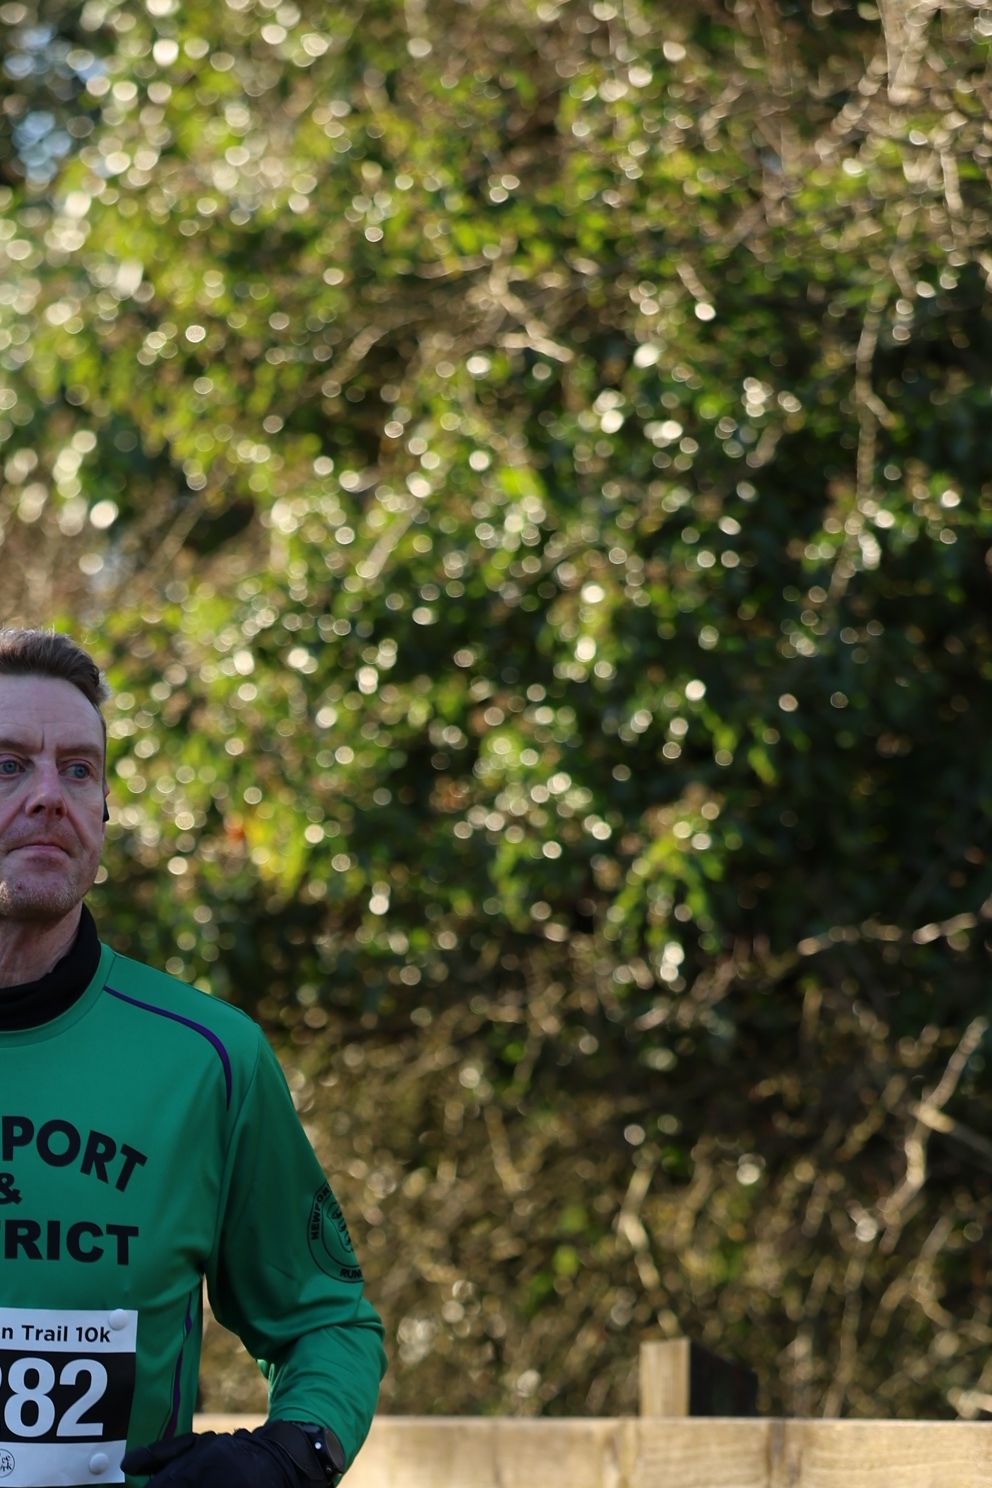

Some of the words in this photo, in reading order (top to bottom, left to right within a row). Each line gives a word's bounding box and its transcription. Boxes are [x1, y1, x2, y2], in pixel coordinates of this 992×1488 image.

[311, 1183, 330, 1240] NEWPOR
[21, 1324, 68, 1342] Trail
[77, 1326, 111, 1343] 10k
